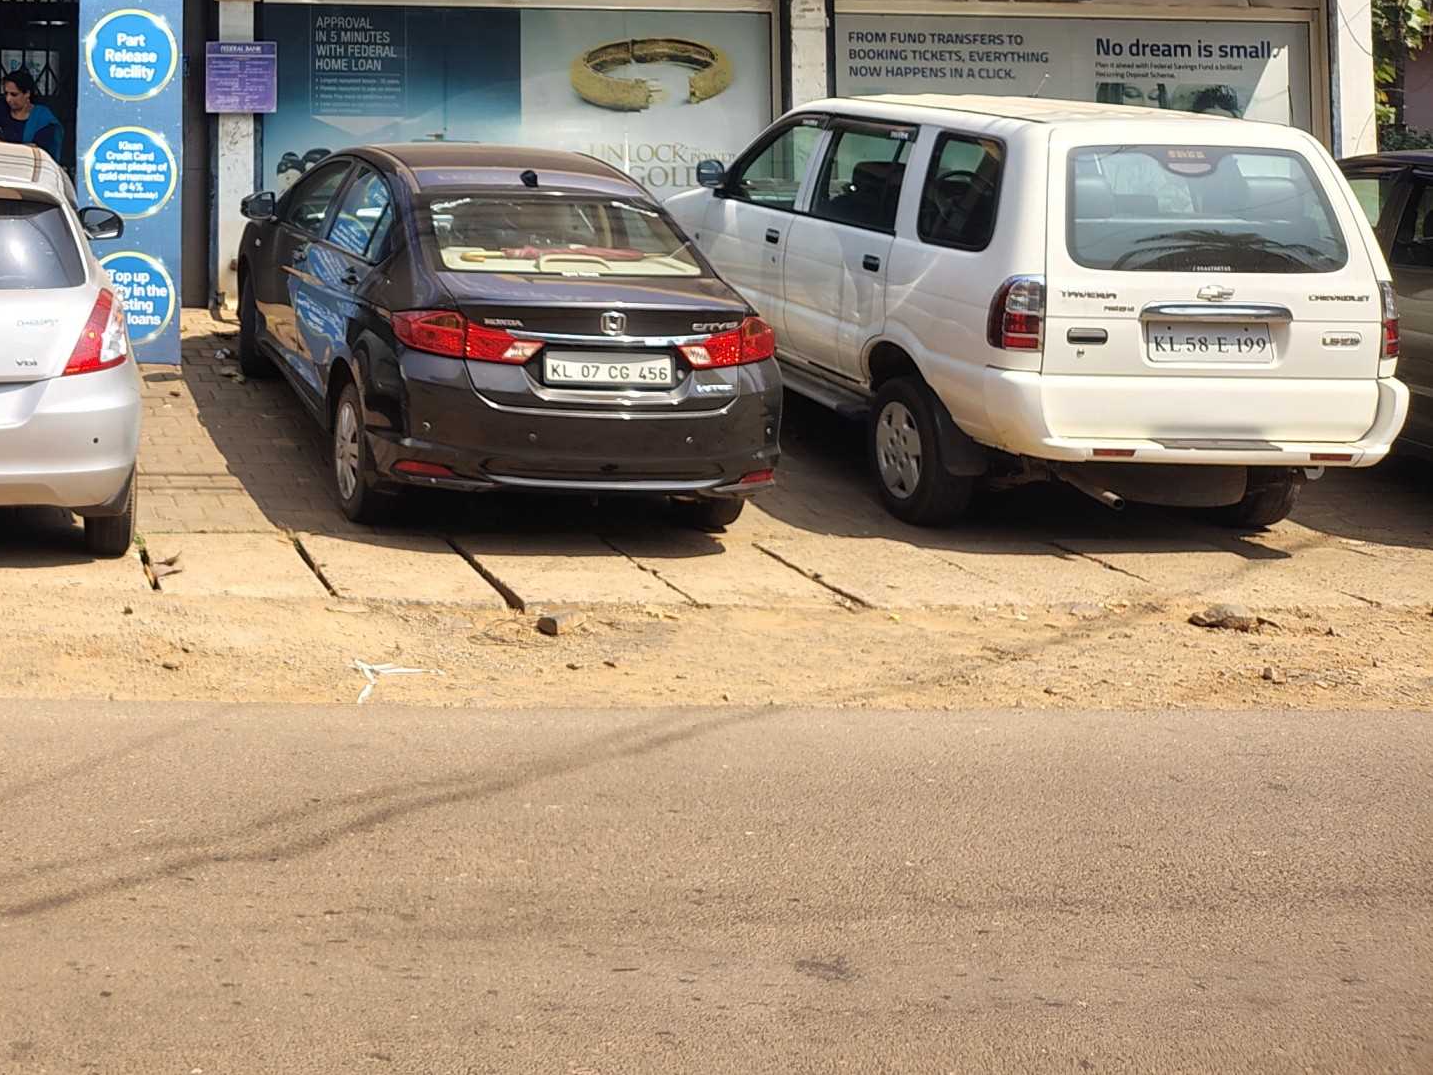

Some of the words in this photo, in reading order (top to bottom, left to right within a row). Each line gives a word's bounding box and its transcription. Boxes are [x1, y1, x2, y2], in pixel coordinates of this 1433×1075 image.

[315, 15, 374, 30] APPROVAL
[117, 33, 146, 47] Part
[315, 30, 327, 42] IN
[330, 30, 338, 43] 5
[340, 31, 391, 44] MINUTES
[848, 31, 887, 44] FROM
[890, 32, 927, 44] FUND
[929, 32, 1005, 46] TRANSFERS
[1008, 34, 1024, 46] TO
[316, 43, 345, 57] WITH
[348, 44, 398, 58] FEDERAL
[1095, 37, 1124, 57] No
[1128, 38, 1192, 58] dream
[1197, 39, 1214, 58] is
[104, 48, 158, 64] Release
[848, 48, 908, 61] BOOKING
[911, 49, 966, 64] TICKETS,
[968, 50, 1049, 64] EVERYTHING
[109, 64, 155, 80] facility
[315, 57, 349, 71] HOME
[351, 59, 382, 72] LOAN
[848, 65, 883, 78] NOW
[885, 66, 947, 79] HAPPENS
[950, 67, 964, 79] IN
[966, 67, 976, 79] A
[589, 142, 689, 164] UNLOCK
[133, 272, 151, 285] up
[133, 284, 146, 297] in
[146, 285, 168, 298] the
[127, 313, 162, 326] loans
[550, 364, 574, 379] KL
[580, 365, 602, 380] 07
[637, 366, 669, 382] 456
